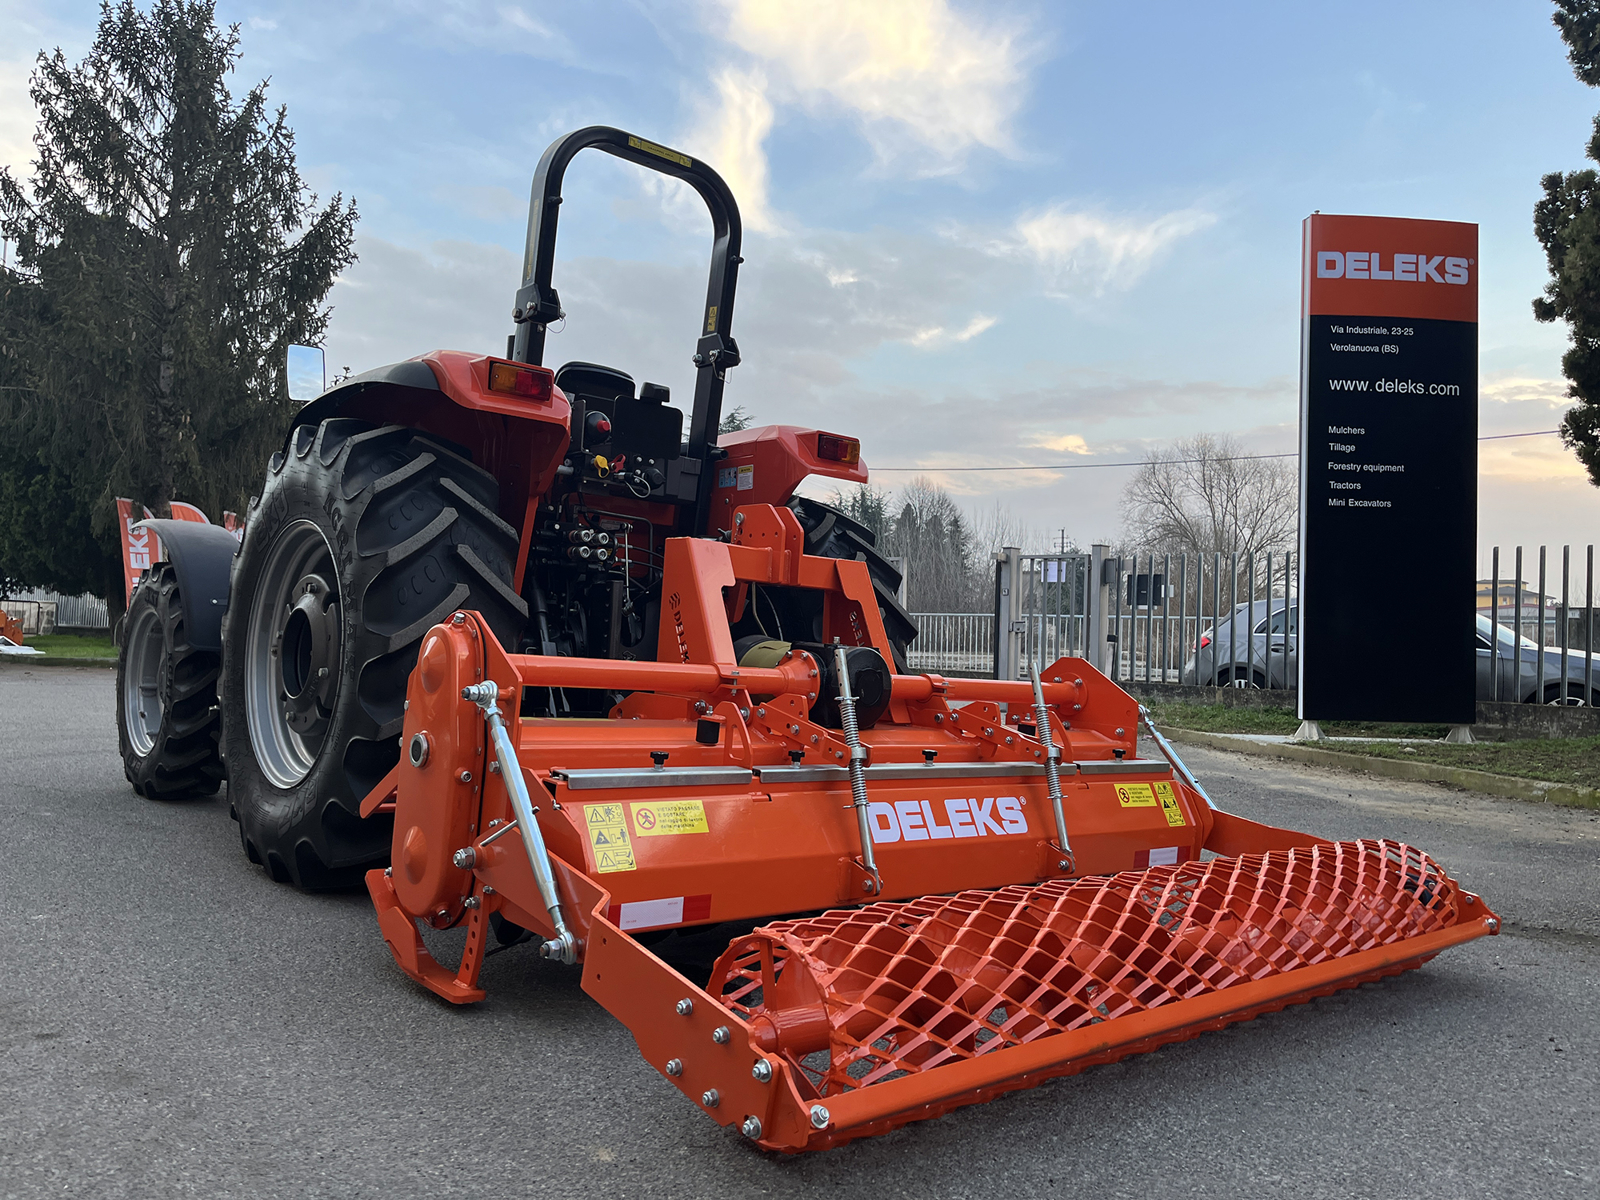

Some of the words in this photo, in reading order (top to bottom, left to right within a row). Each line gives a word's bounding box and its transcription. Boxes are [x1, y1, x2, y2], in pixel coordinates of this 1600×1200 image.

[1330, 325, 1344, 334] Via
[1346, 325, 1390, 335] Industriale,
[1391, 326, 1414, 336] 23-25
[1330, 343, 1380, 353] Verolanuova
[1381, 344, 1399, 354] (BS)
[1329, 377, 1460, 396] www.deleks.com
[1328, 425, 1366, 435] Mulchers
[1329, 442, 1356, 453] Tillage
[1328, 461, 1362, 473] Forestry
[1363, 463, 1405, 473] equipment
[1329, 480, 1362, 490] Tractors
[1328, 498, 1346, 507] Mini
[1348, 498, 1392, 508] Excavators
